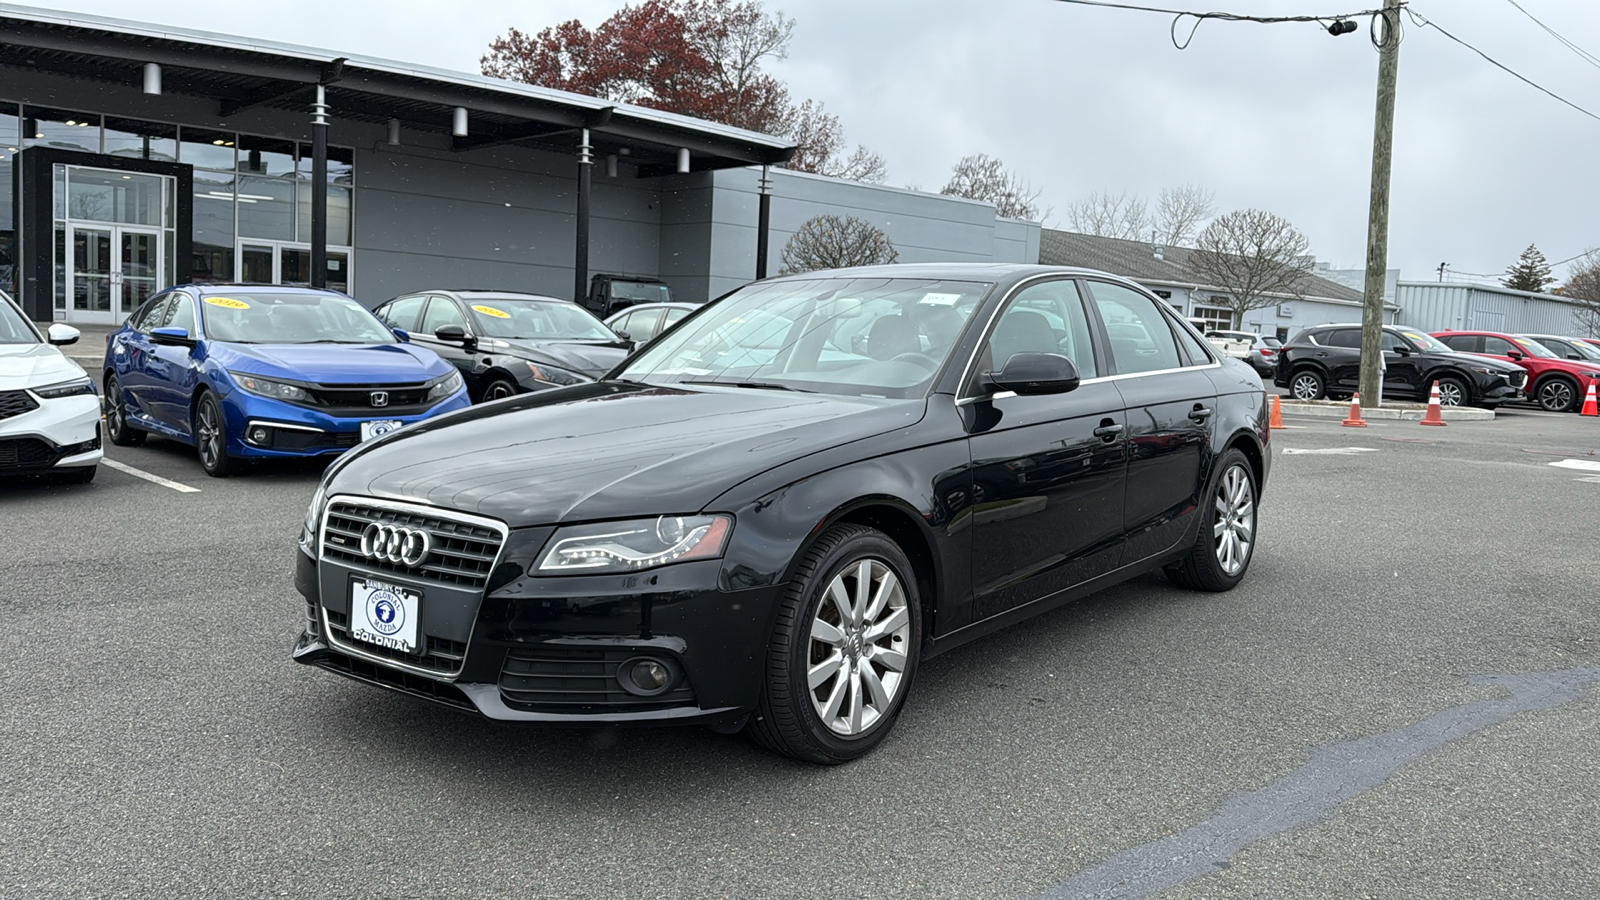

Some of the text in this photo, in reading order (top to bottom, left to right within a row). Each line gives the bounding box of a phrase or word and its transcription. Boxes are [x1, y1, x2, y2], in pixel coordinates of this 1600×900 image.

[371, 591, 400, 611] COLONIAL
[374, 619, 396, 631] MAZDA
[353, 630, 410, 653] COLONIAL
